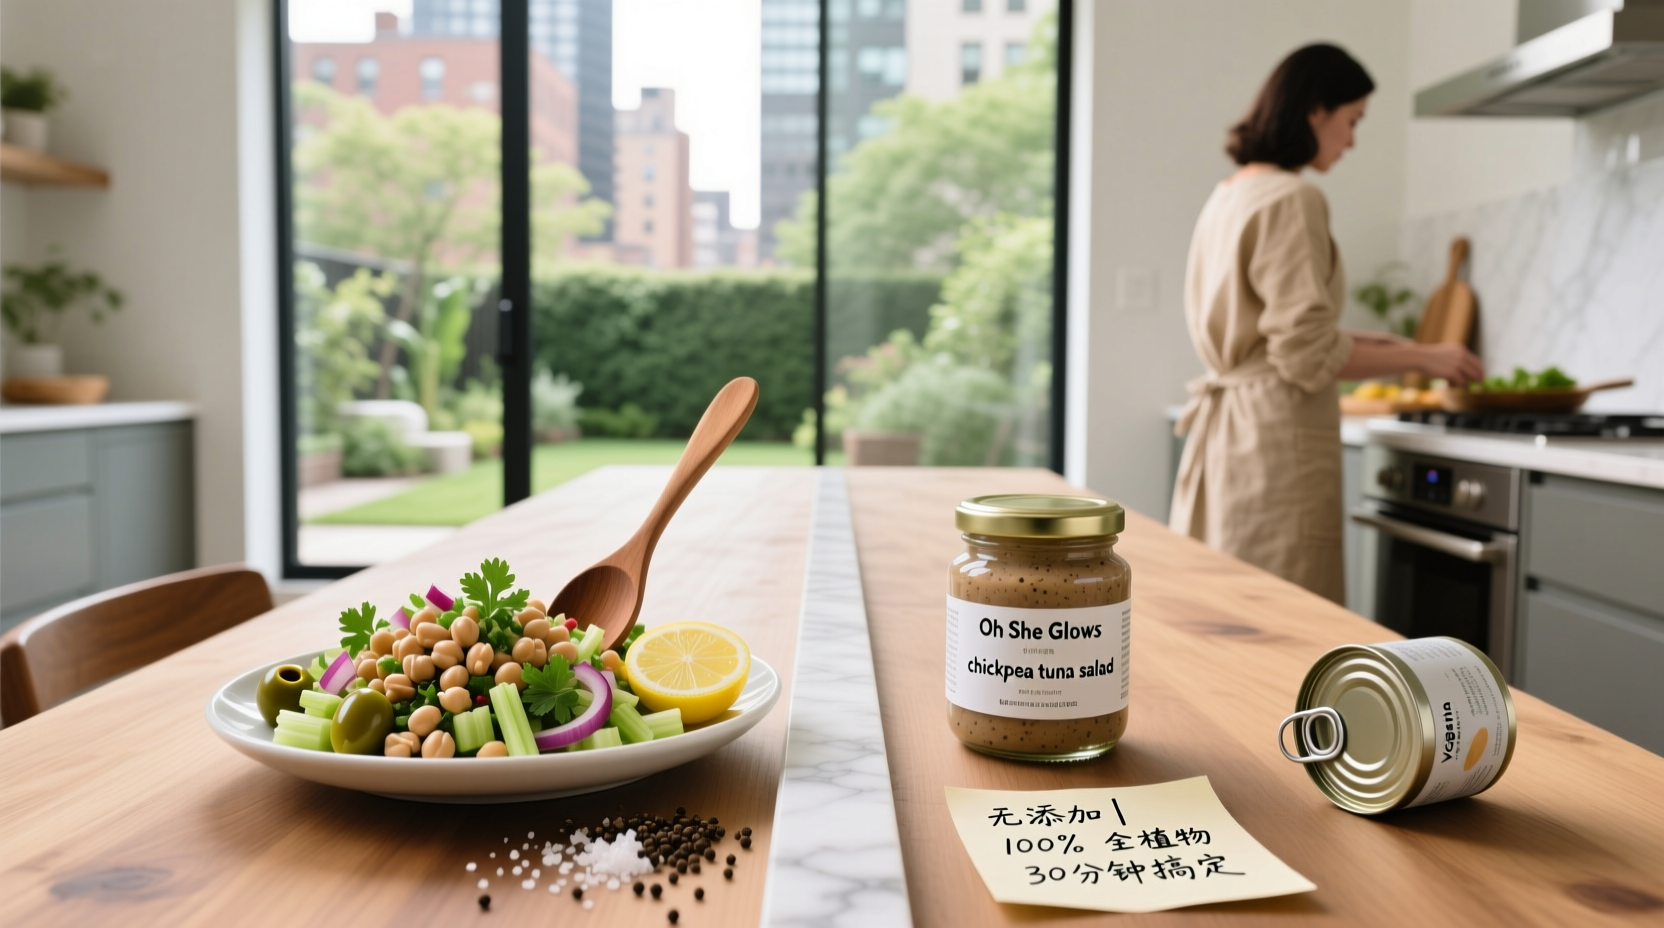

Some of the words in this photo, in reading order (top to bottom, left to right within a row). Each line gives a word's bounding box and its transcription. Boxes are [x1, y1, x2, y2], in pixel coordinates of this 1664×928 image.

[979, 617, 1004, 639] Oh
[1008, 620, 1044, 640] She
[1048, 621, 1103, 641] Glows
[967, 656, 1034, 683] chickpea
[1037, 663, 1075, 680] tuna
[1079, 656, 1114, 679] salad
[987, 804, 1102, 827] 无添加
[1006, 834, 1085, 855] 100%
[1104, 827, 1212, 853] 全植物
[1024, 853, 1246, 886] 30分钟搞定
